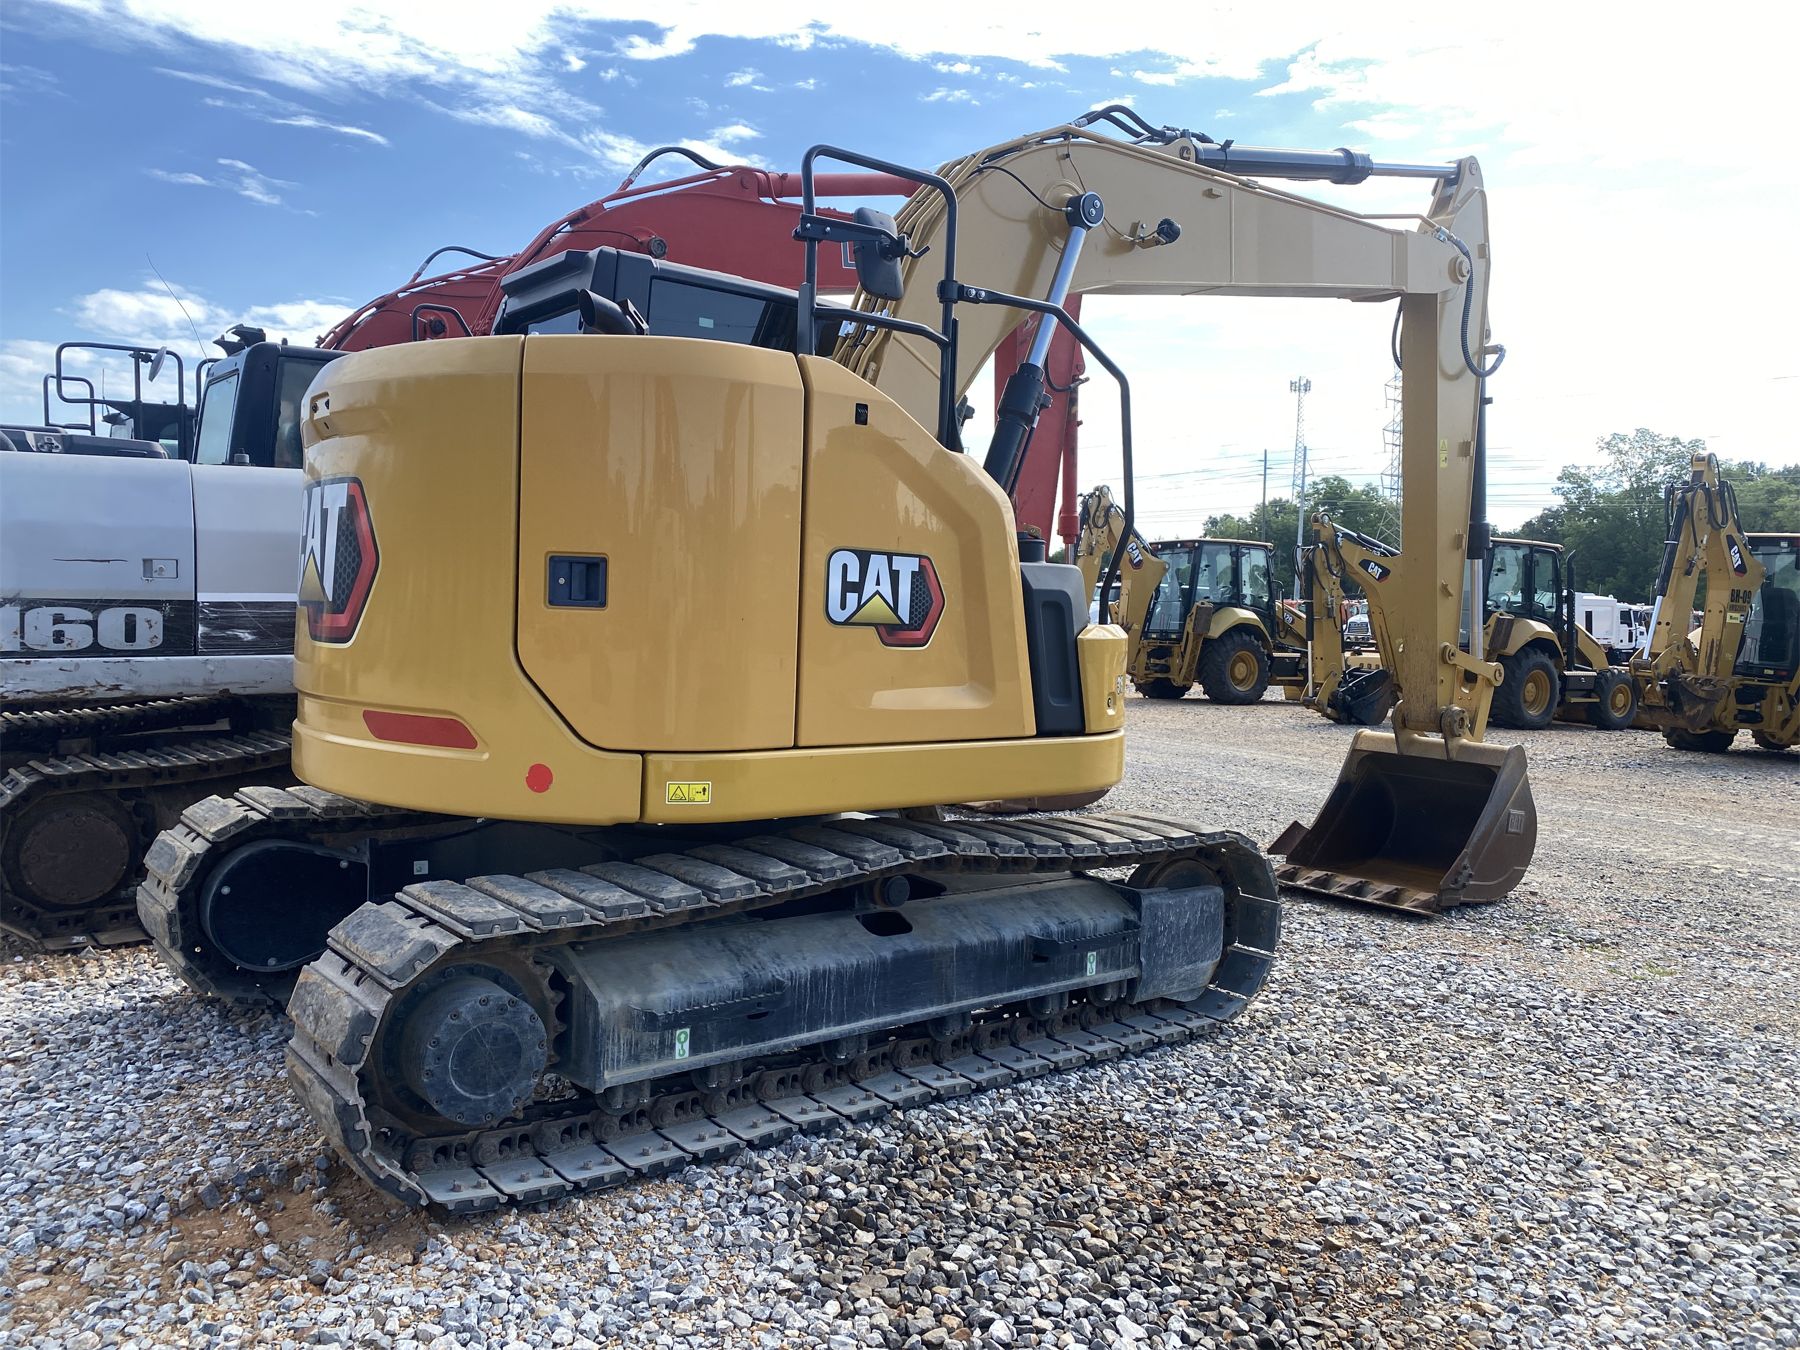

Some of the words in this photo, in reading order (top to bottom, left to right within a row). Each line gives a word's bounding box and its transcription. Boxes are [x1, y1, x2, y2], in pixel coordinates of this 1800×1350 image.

[301, 482, 349, 602] CAT
[1127, 542, 1144, 564] CAT
[1730, 546, 1742, 568] CAT
[1368, 562, 1382, 579] CAT
[828, 551, 920, 624] CAT
[1730, 589, 1752, 604] BH-09
